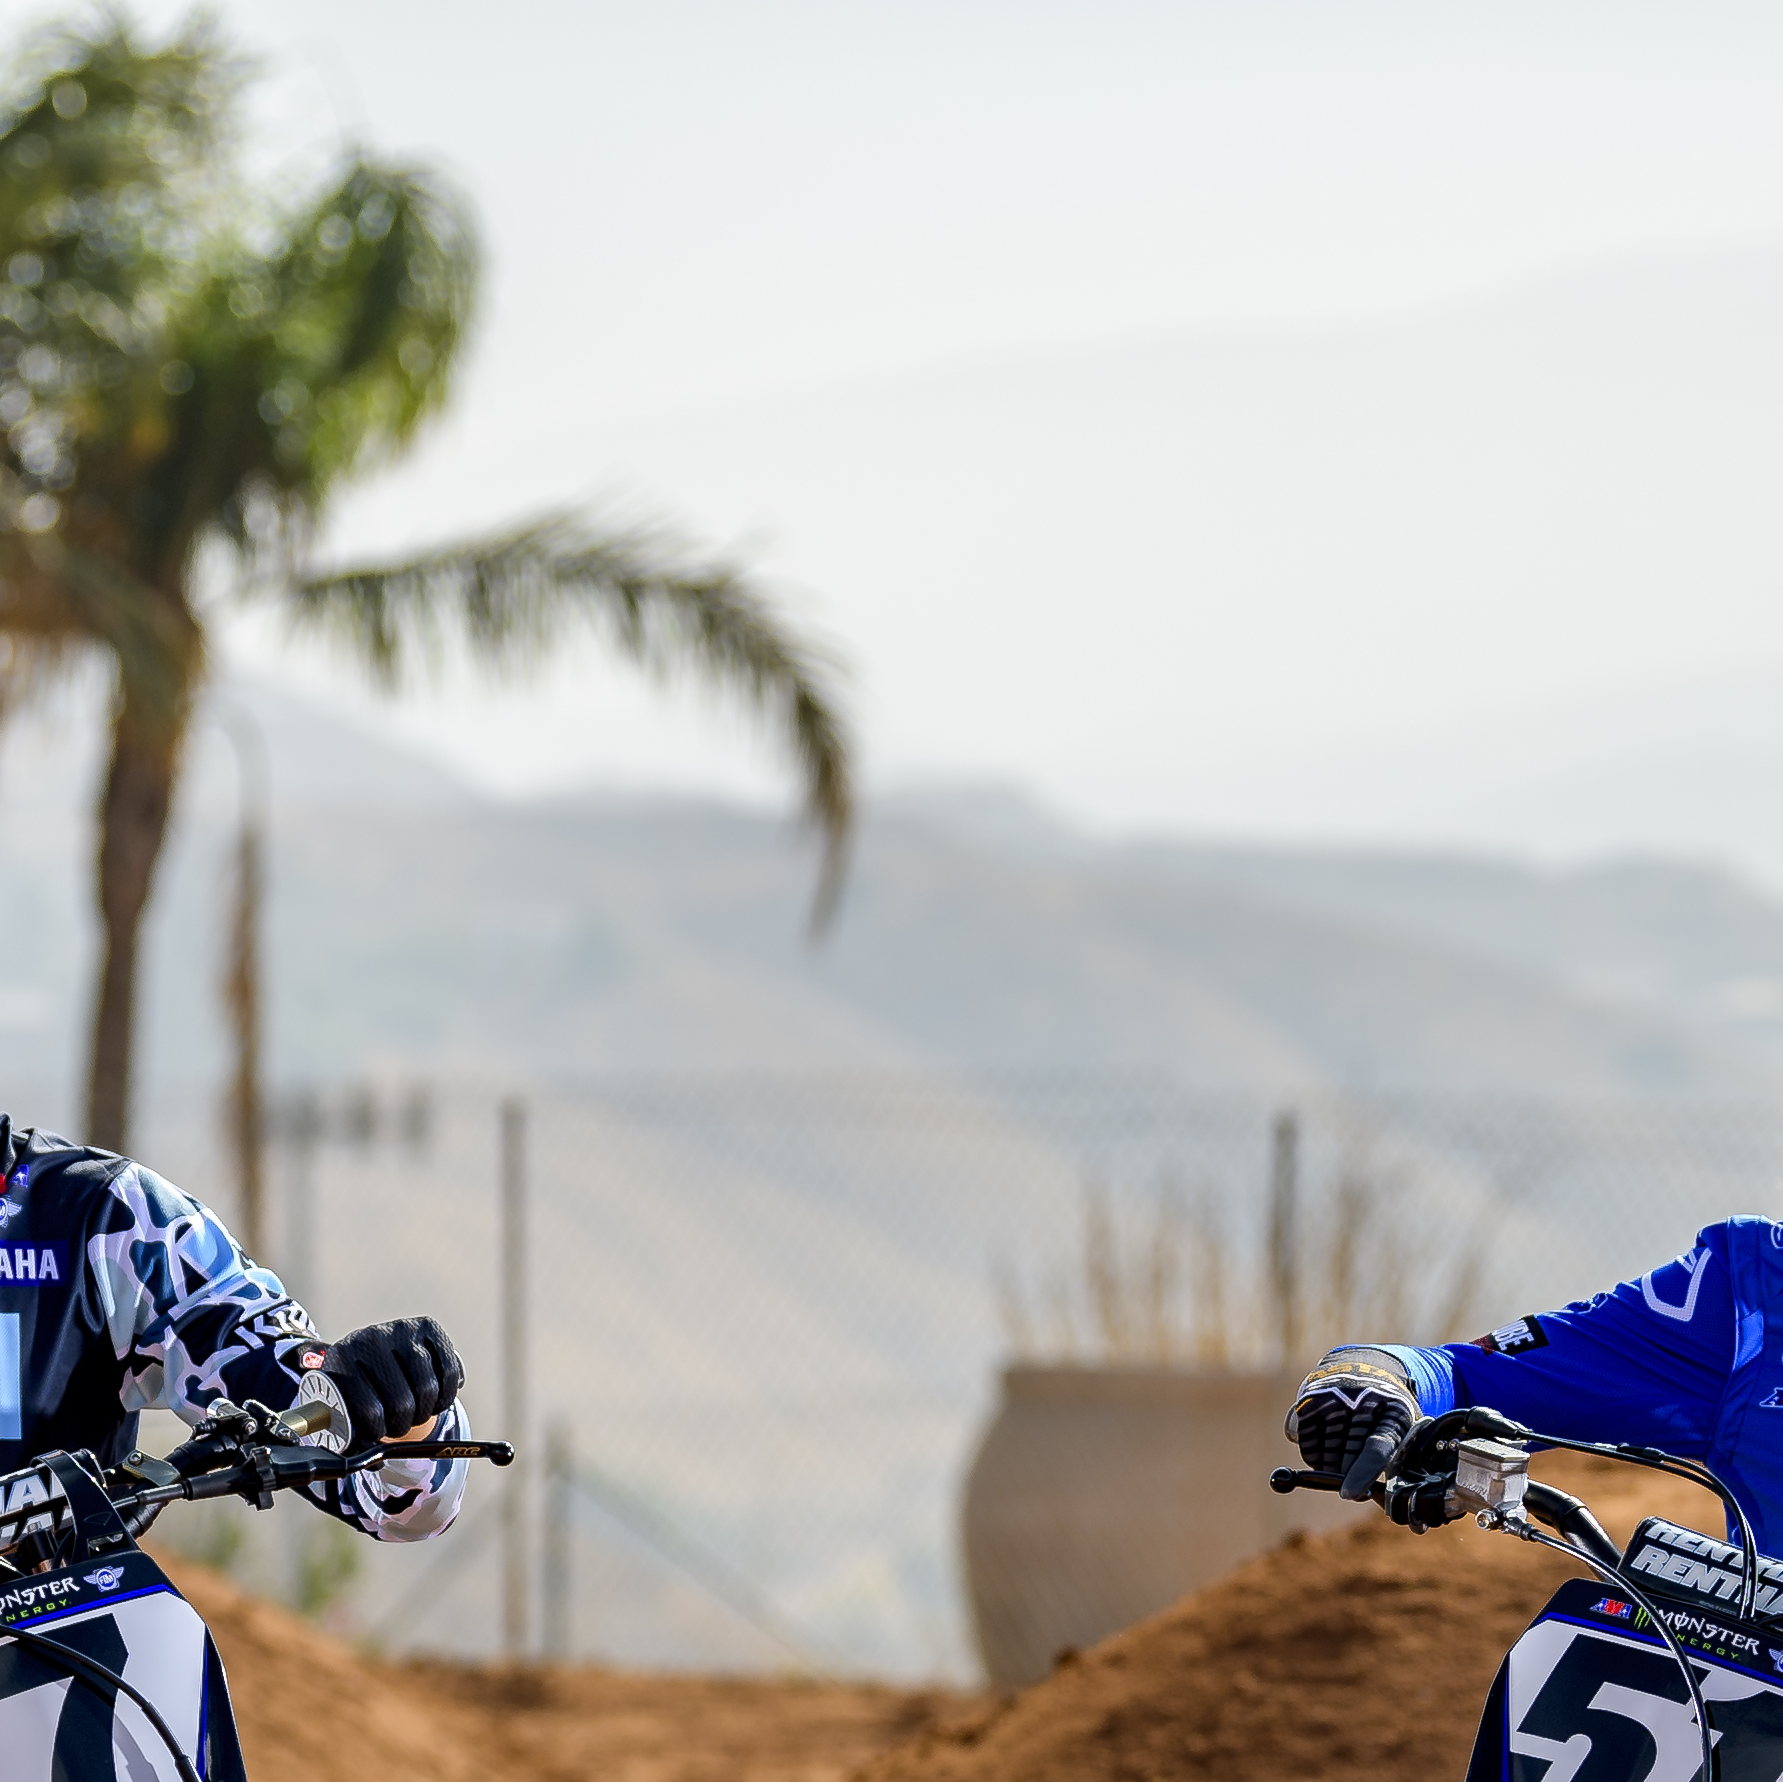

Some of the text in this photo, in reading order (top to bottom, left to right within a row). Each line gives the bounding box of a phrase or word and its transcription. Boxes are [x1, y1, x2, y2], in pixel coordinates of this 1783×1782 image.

[437, 1446, 481, 1459] ARC
[1590, 1598, 1632, 1619] AMA
[1675, 1632, 1740, 1660] NERGY
